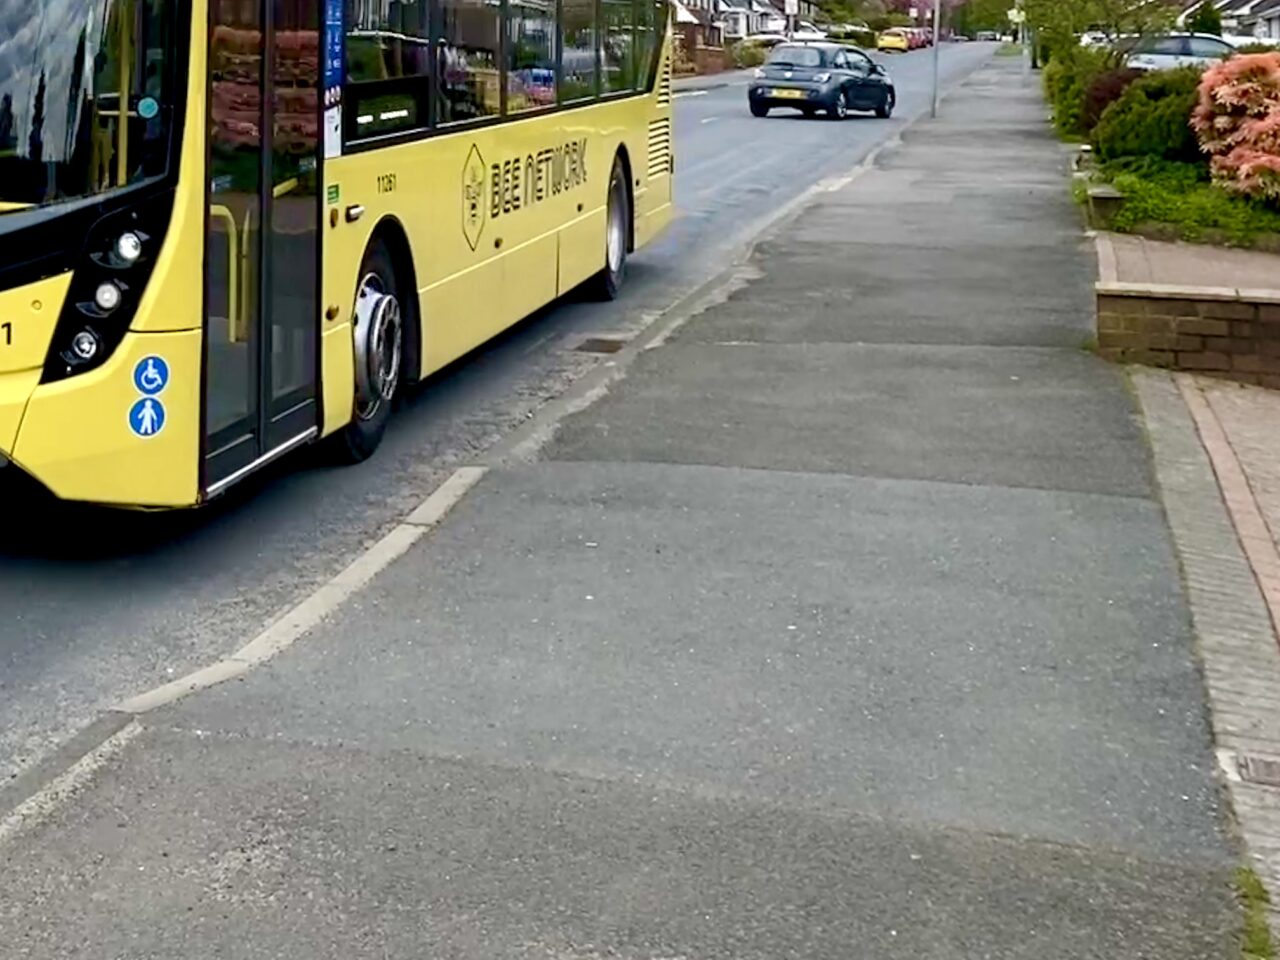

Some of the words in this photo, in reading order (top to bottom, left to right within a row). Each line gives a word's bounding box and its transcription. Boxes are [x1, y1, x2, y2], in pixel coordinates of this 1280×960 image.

[377, 172, 397, 194] 11261
[491, 157, 521, 219] BEE
[523, 137, 587, 208] NETWORK
